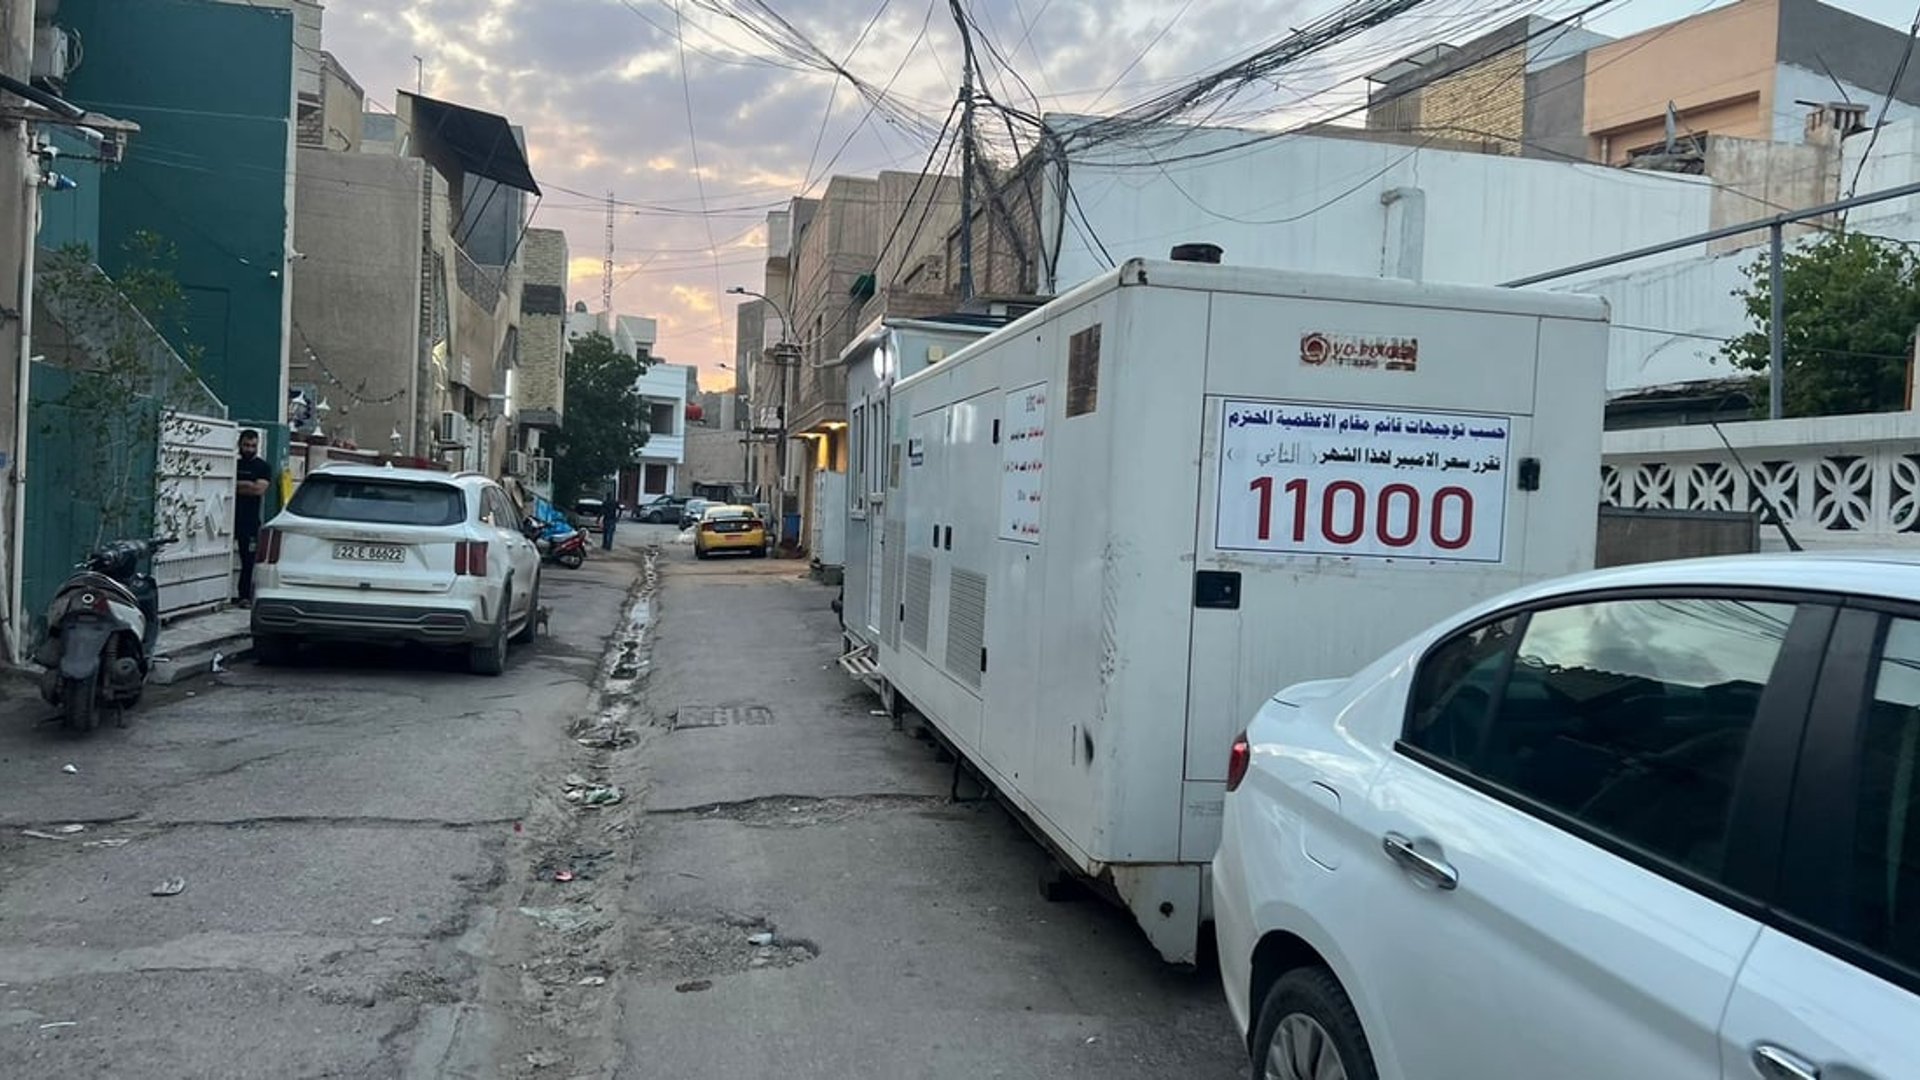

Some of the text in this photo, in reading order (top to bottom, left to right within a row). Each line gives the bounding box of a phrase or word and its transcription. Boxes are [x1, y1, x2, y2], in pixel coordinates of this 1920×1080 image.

[1229, 409, 1273, 428] المحترم
[1276, 410, 1336, 430] الاعظمية
[1339, 413, 1369, 434] مقام
[1405, 420, 1465, 440] توجيهات
[1469, 426, 1505, 441] حسب
[1365, 447, 1391, 464] لهذا
[1394, 451, 1439, 469] الامبير
[1441, 457, 1470, 471] سعر
[1249, 476, 1475, 550] 11000
